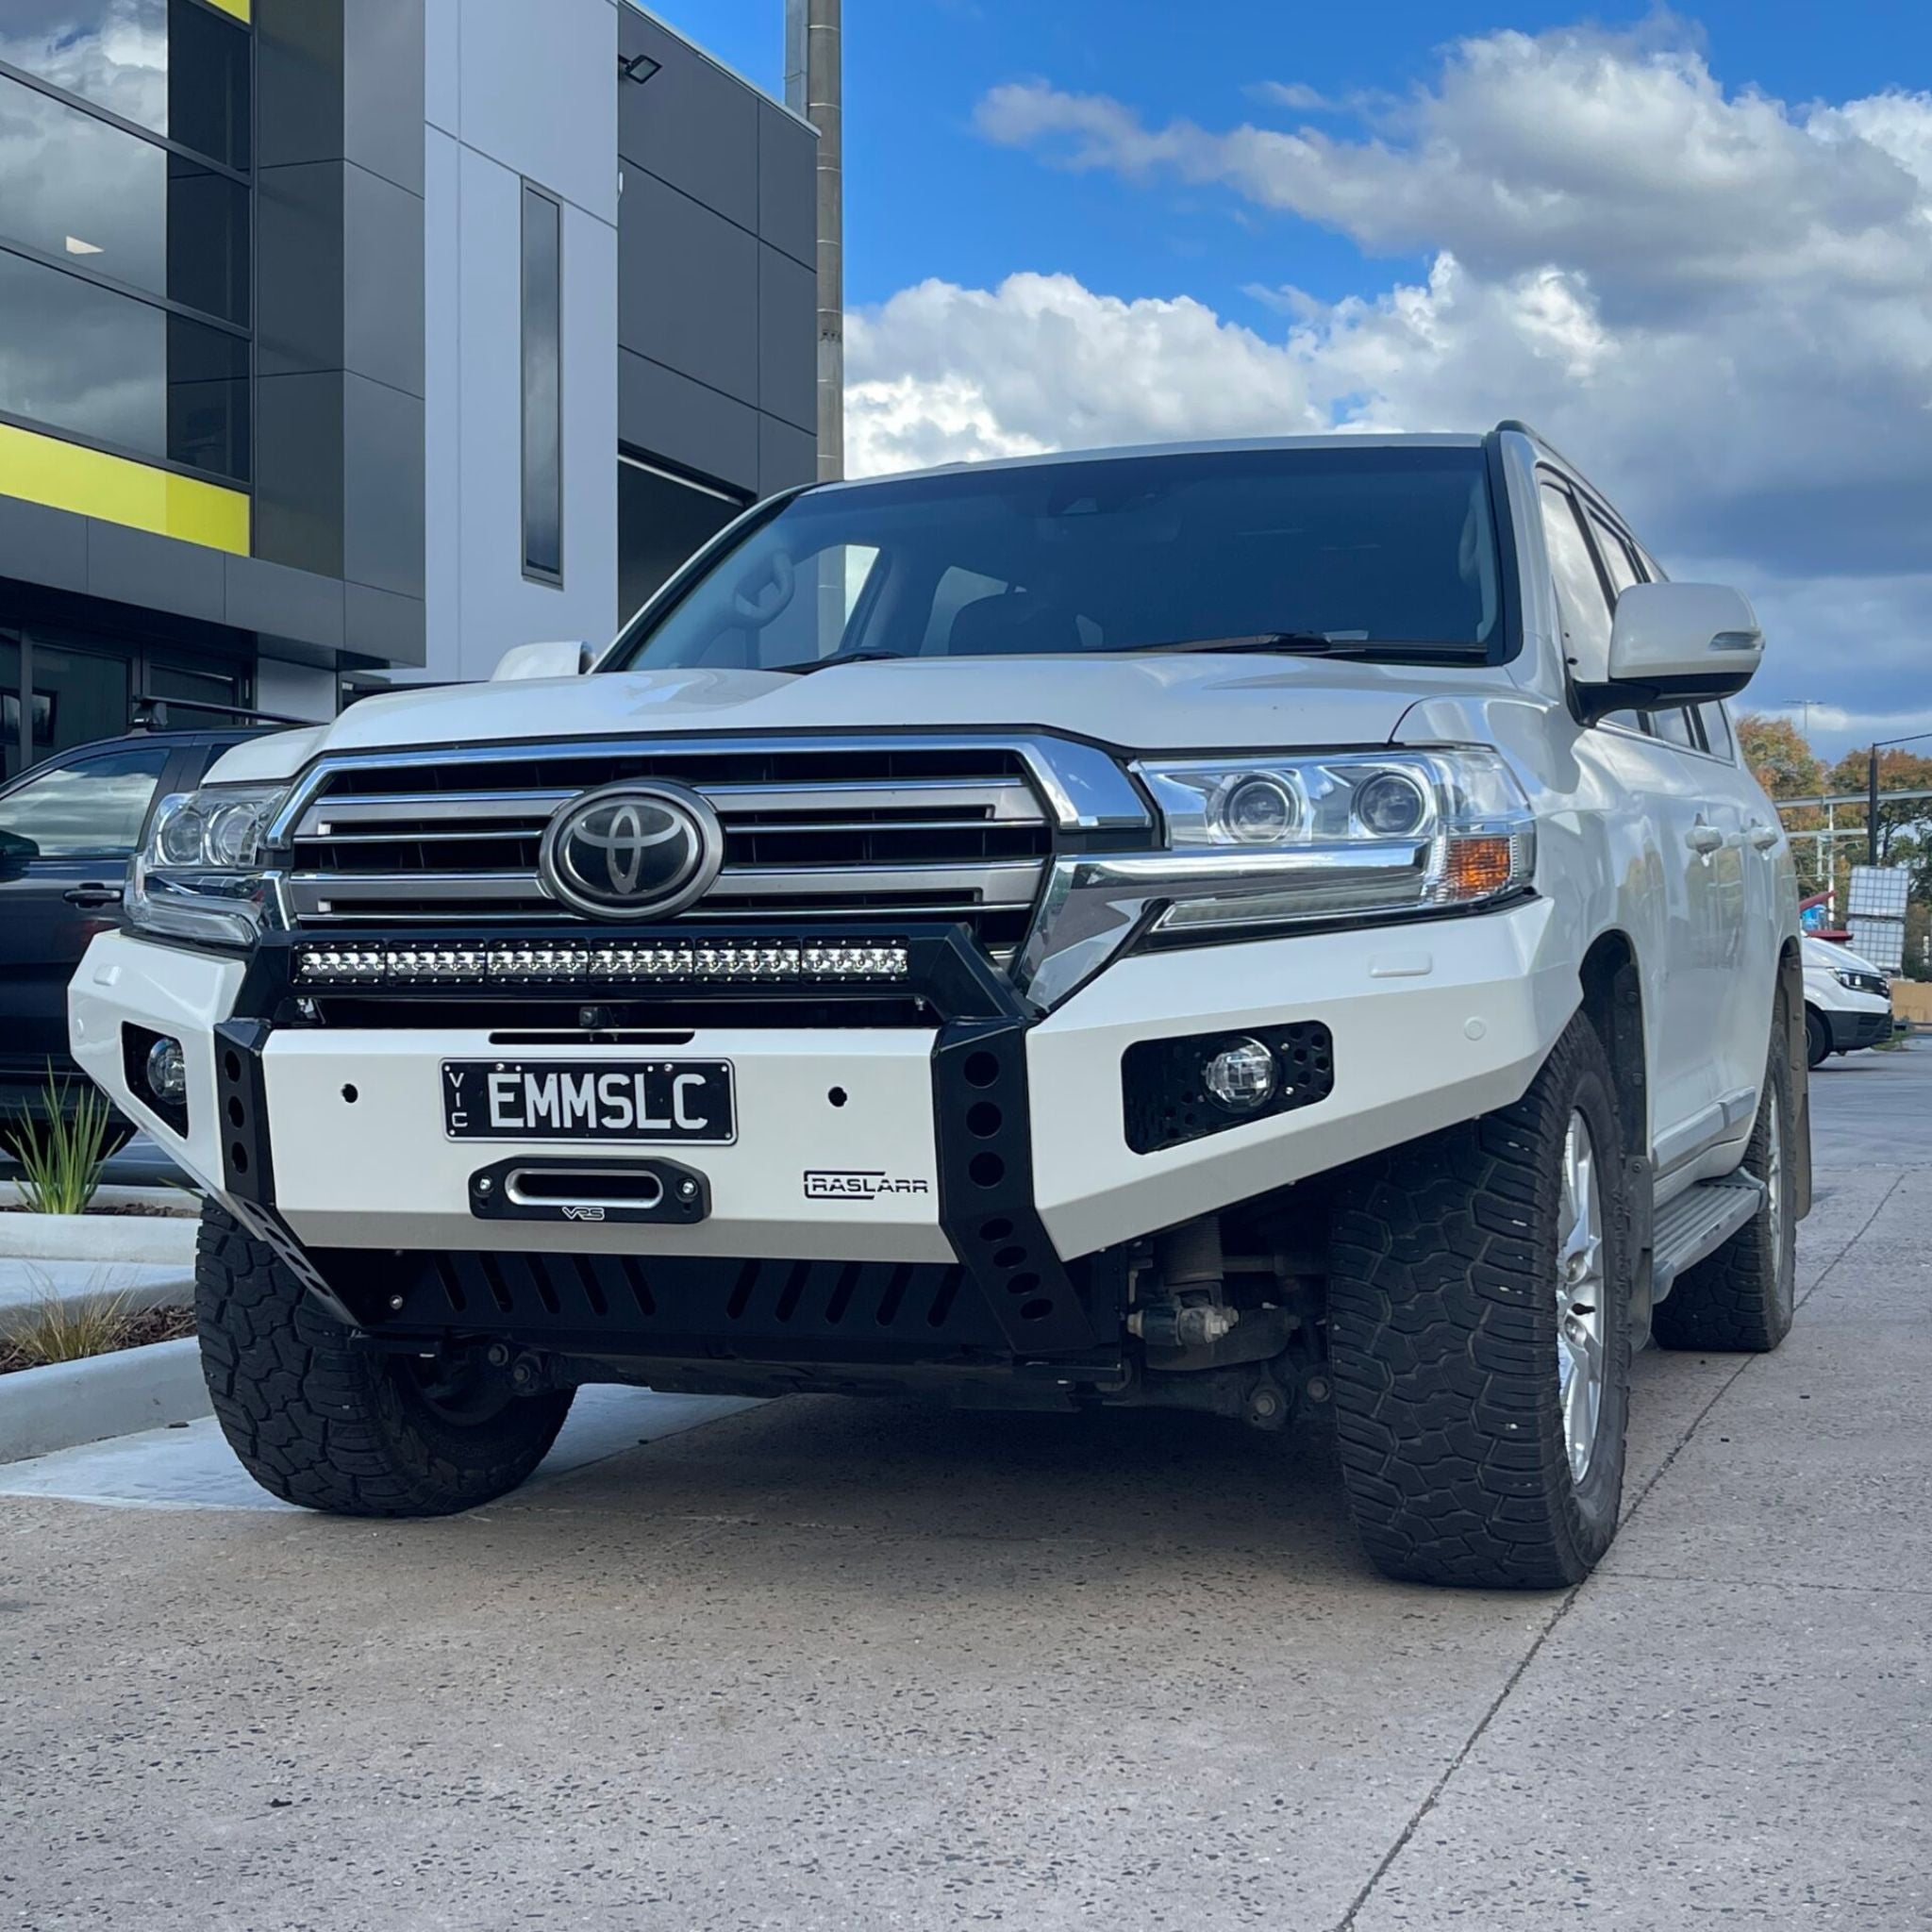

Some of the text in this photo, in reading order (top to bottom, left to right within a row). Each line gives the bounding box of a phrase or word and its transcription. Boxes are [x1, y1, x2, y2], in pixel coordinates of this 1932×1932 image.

[448, 1073, 468, 1127] VIC
[488, 1073, 708, 1129] EMMSLC
[812, 1178, 928, 1193] RASLARR
[562, 1207, 605, 1221] VRS
